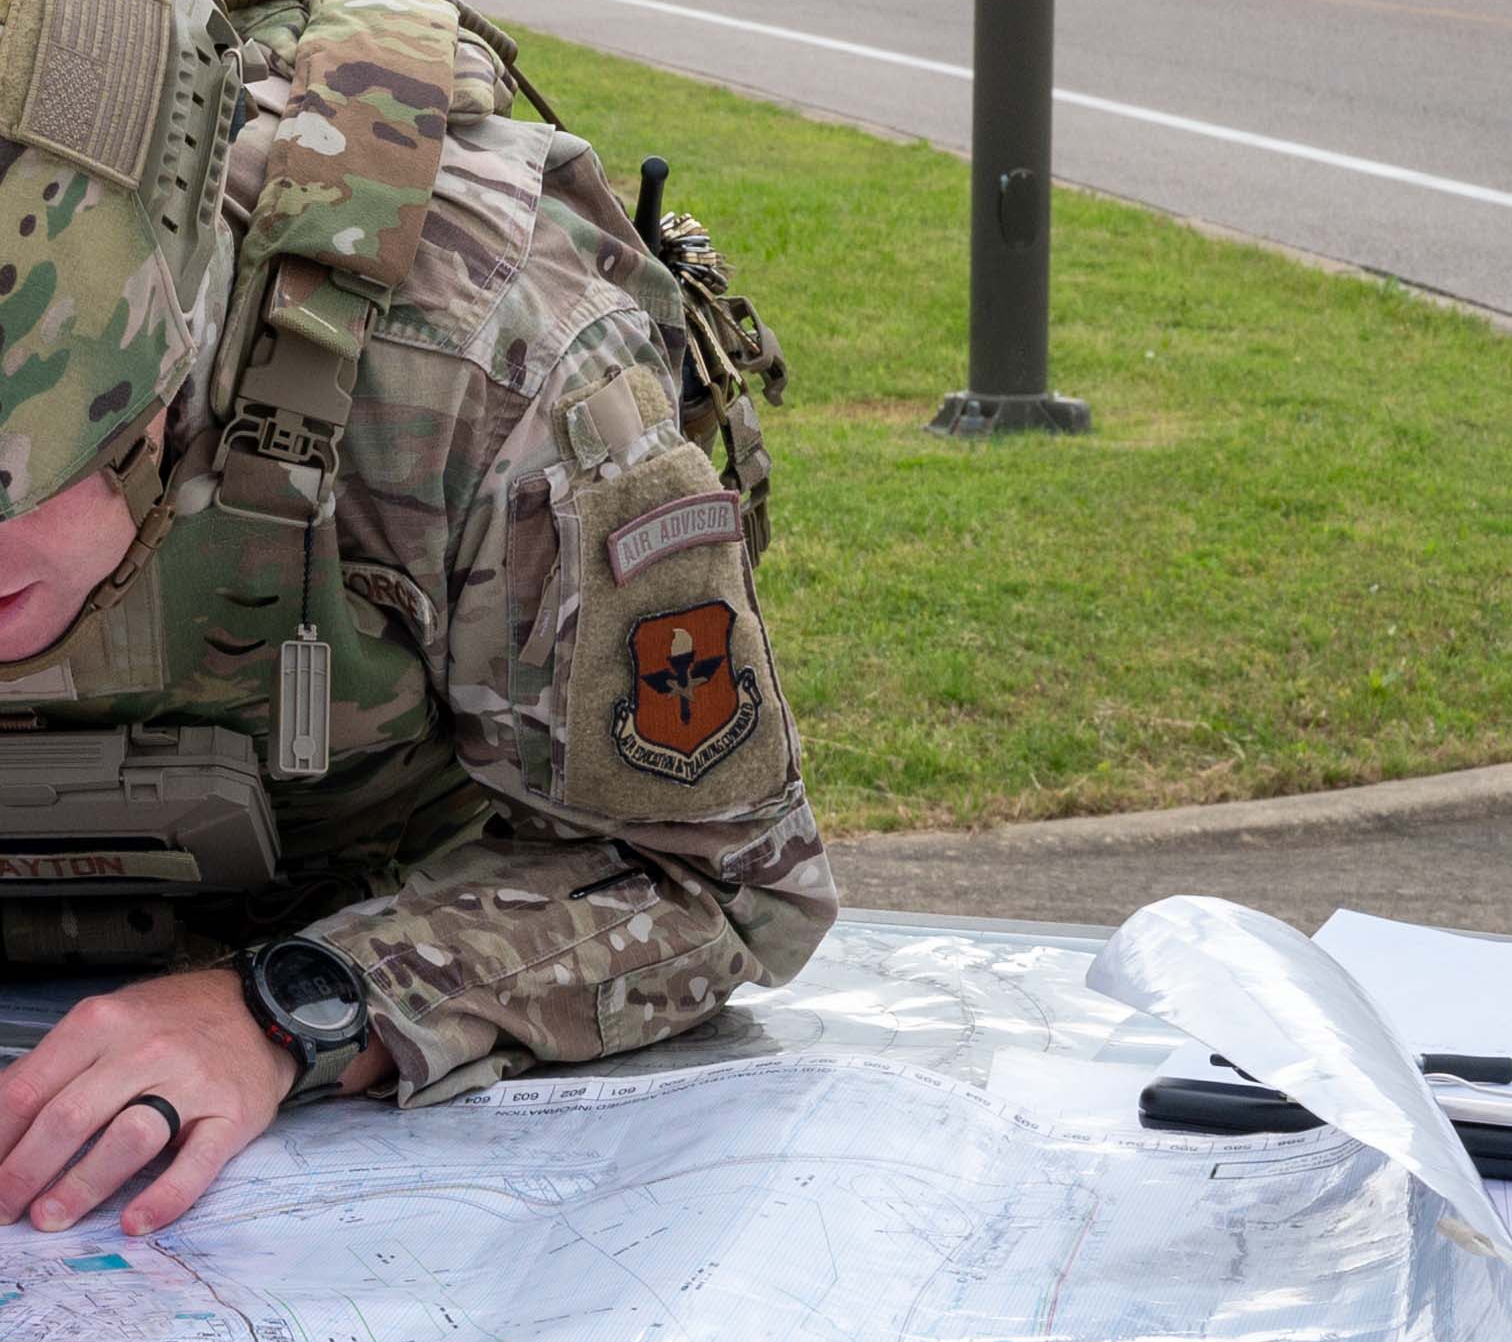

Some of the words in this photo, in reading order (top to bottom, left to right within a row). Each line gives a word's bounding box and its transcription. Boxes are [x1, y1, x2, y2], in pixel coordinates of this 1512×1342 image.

[622, 531, 652, 564] AIR
[660, 506, 728, 543] ADVISOR
[347, 571, 418, 621] ORCE
[683, 740, 724, 778] TRAINING
[512, 1092, 540, 1102] 603
[561, 1088, 586, 1098] 602
[610, 1086, 636, 1096] 601
[495, 1105, 593, 1118] INFORMATION
